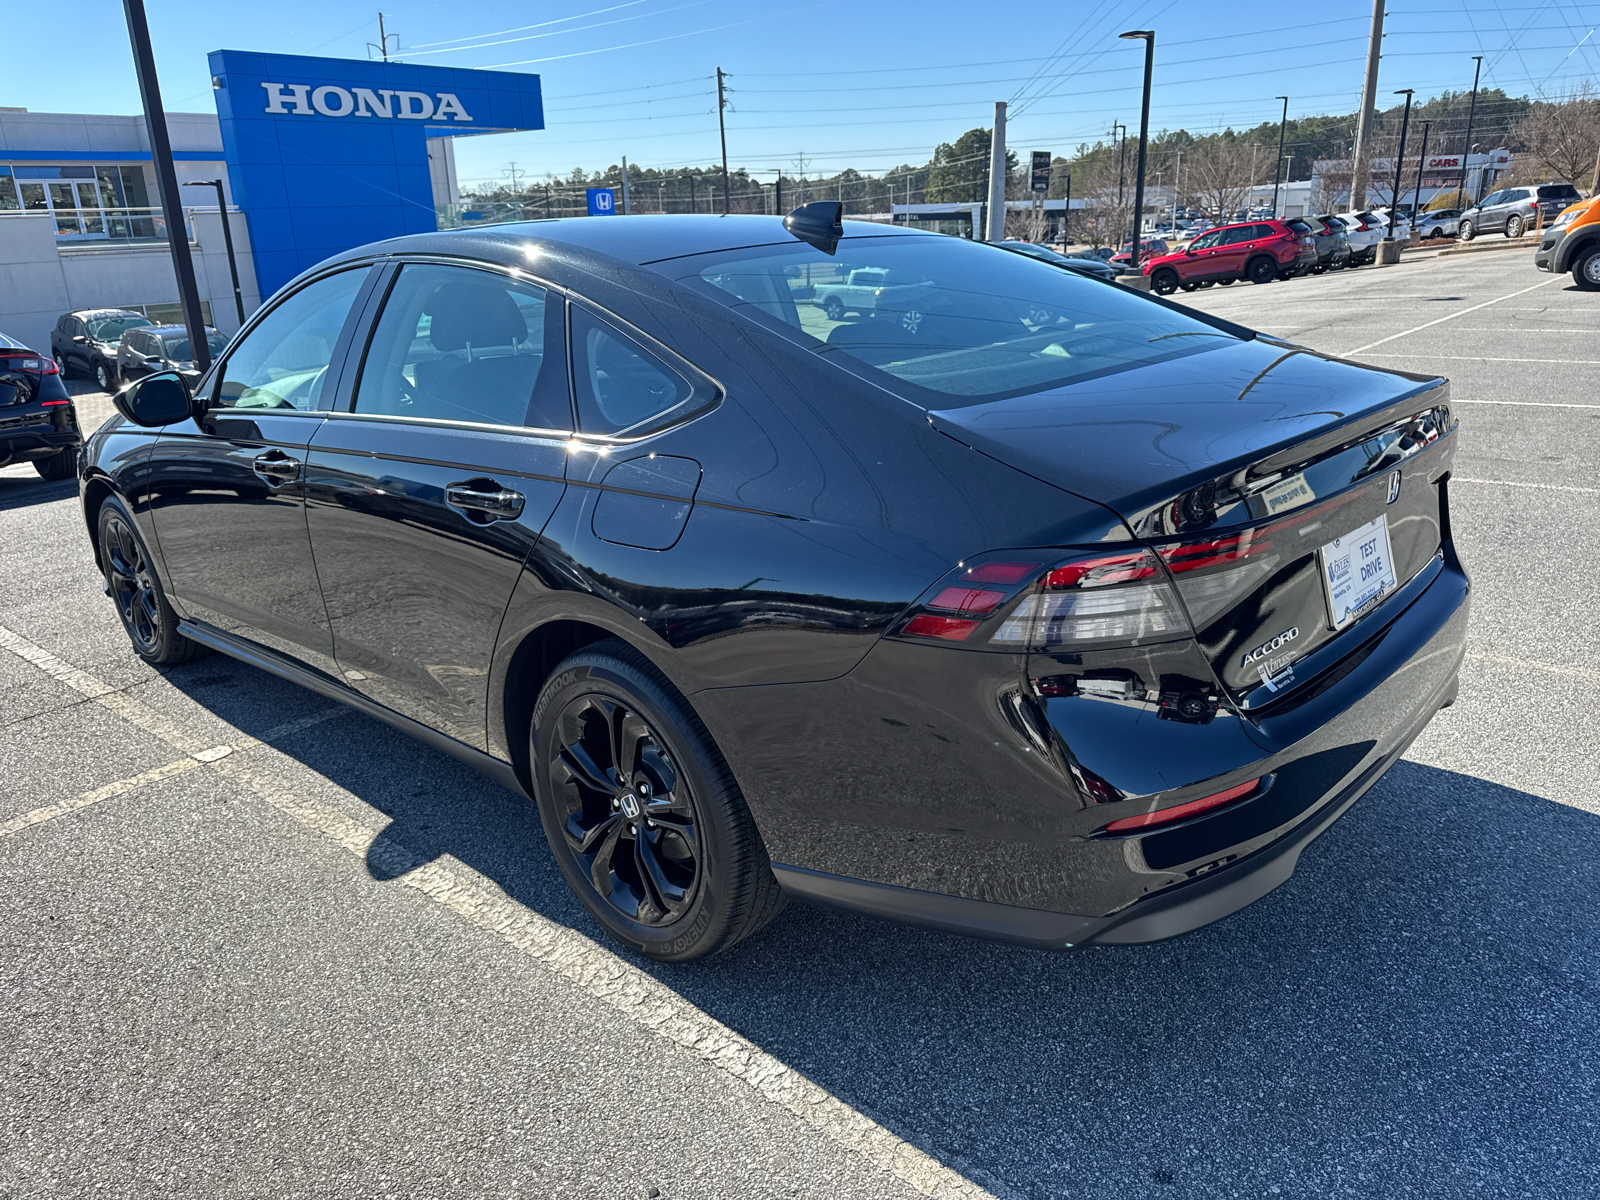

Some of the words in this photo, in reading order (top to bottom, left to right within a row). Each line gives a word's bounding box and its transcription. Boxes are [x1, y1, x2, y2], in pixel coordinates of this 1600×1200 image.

[261, 82, 473, 121] HONDA
[1429, 158, 1459, 168] CARS
[1359, 537, 1377, 560] TEST
[1360, 556, 1383, 582] DRIVE
[1242, 626, 1299, 669] ACCORD
[1263, 652, 1291, 679] VOYLES
[673, 905, 711, 953] KINERGY
[660, 942, 672, 953] GT
